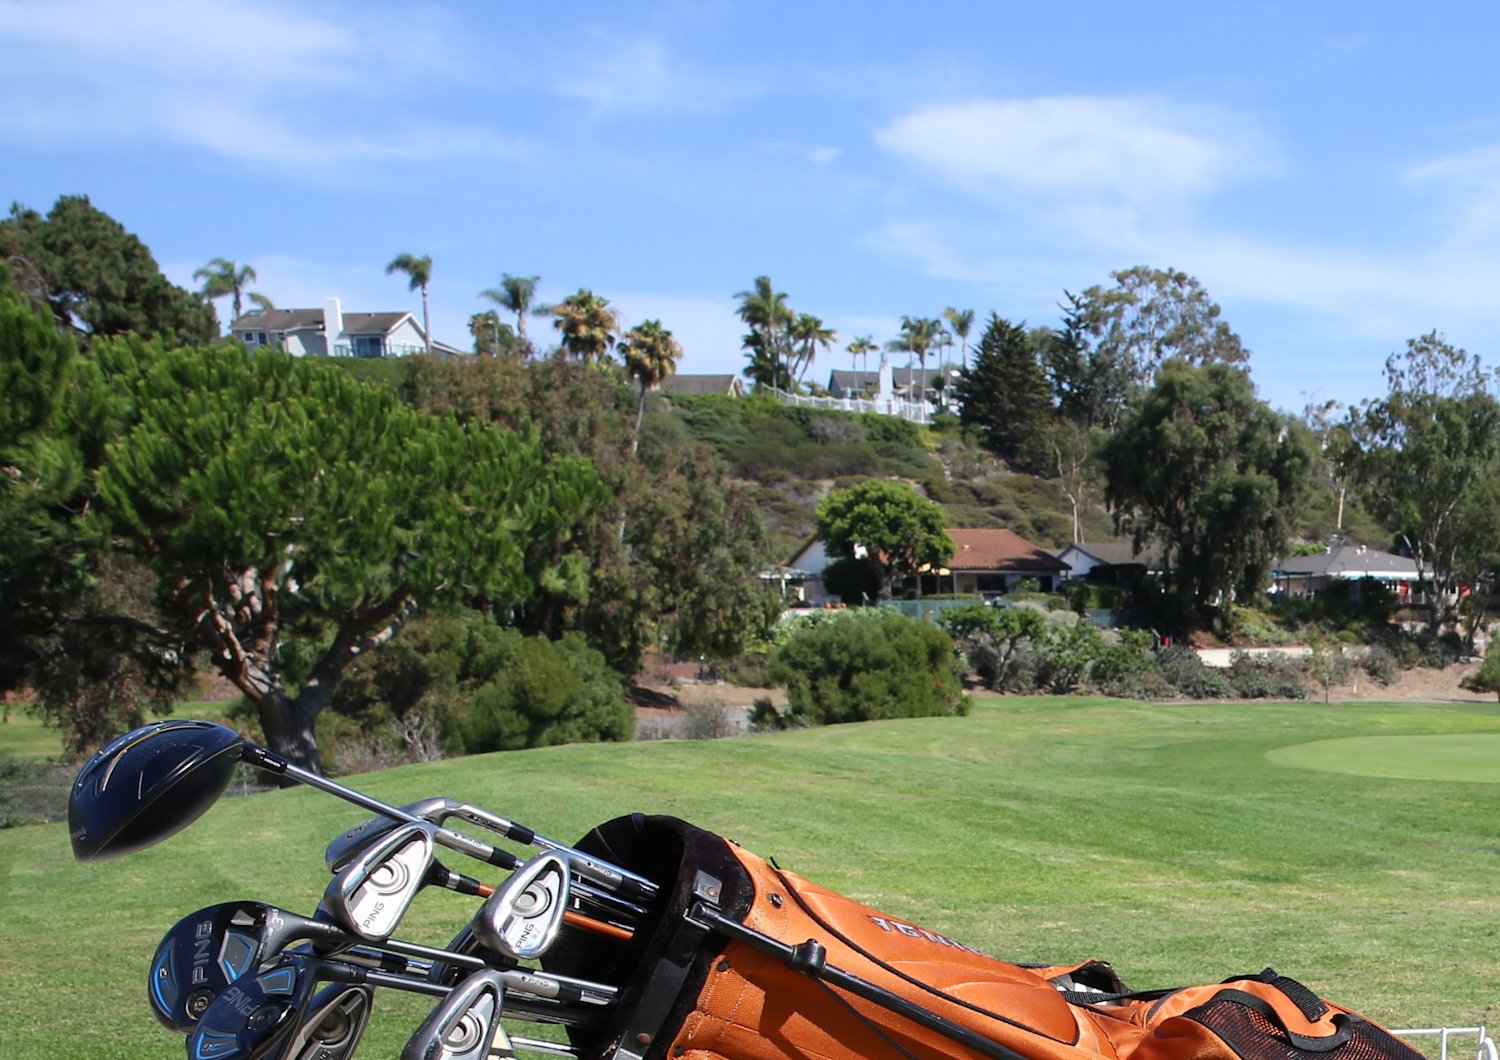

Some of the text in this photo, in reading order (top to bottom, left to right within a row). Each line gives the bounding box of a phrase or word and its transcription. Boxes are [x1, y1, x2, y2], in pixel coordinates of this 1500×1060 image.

[363, 901, 385, 929] PING
[516, 923, 535, 949] PING
[191, 919, 213, 985] PING
[528, 977, 550, 988] PING
[222, 985, 260, 1017] PING
